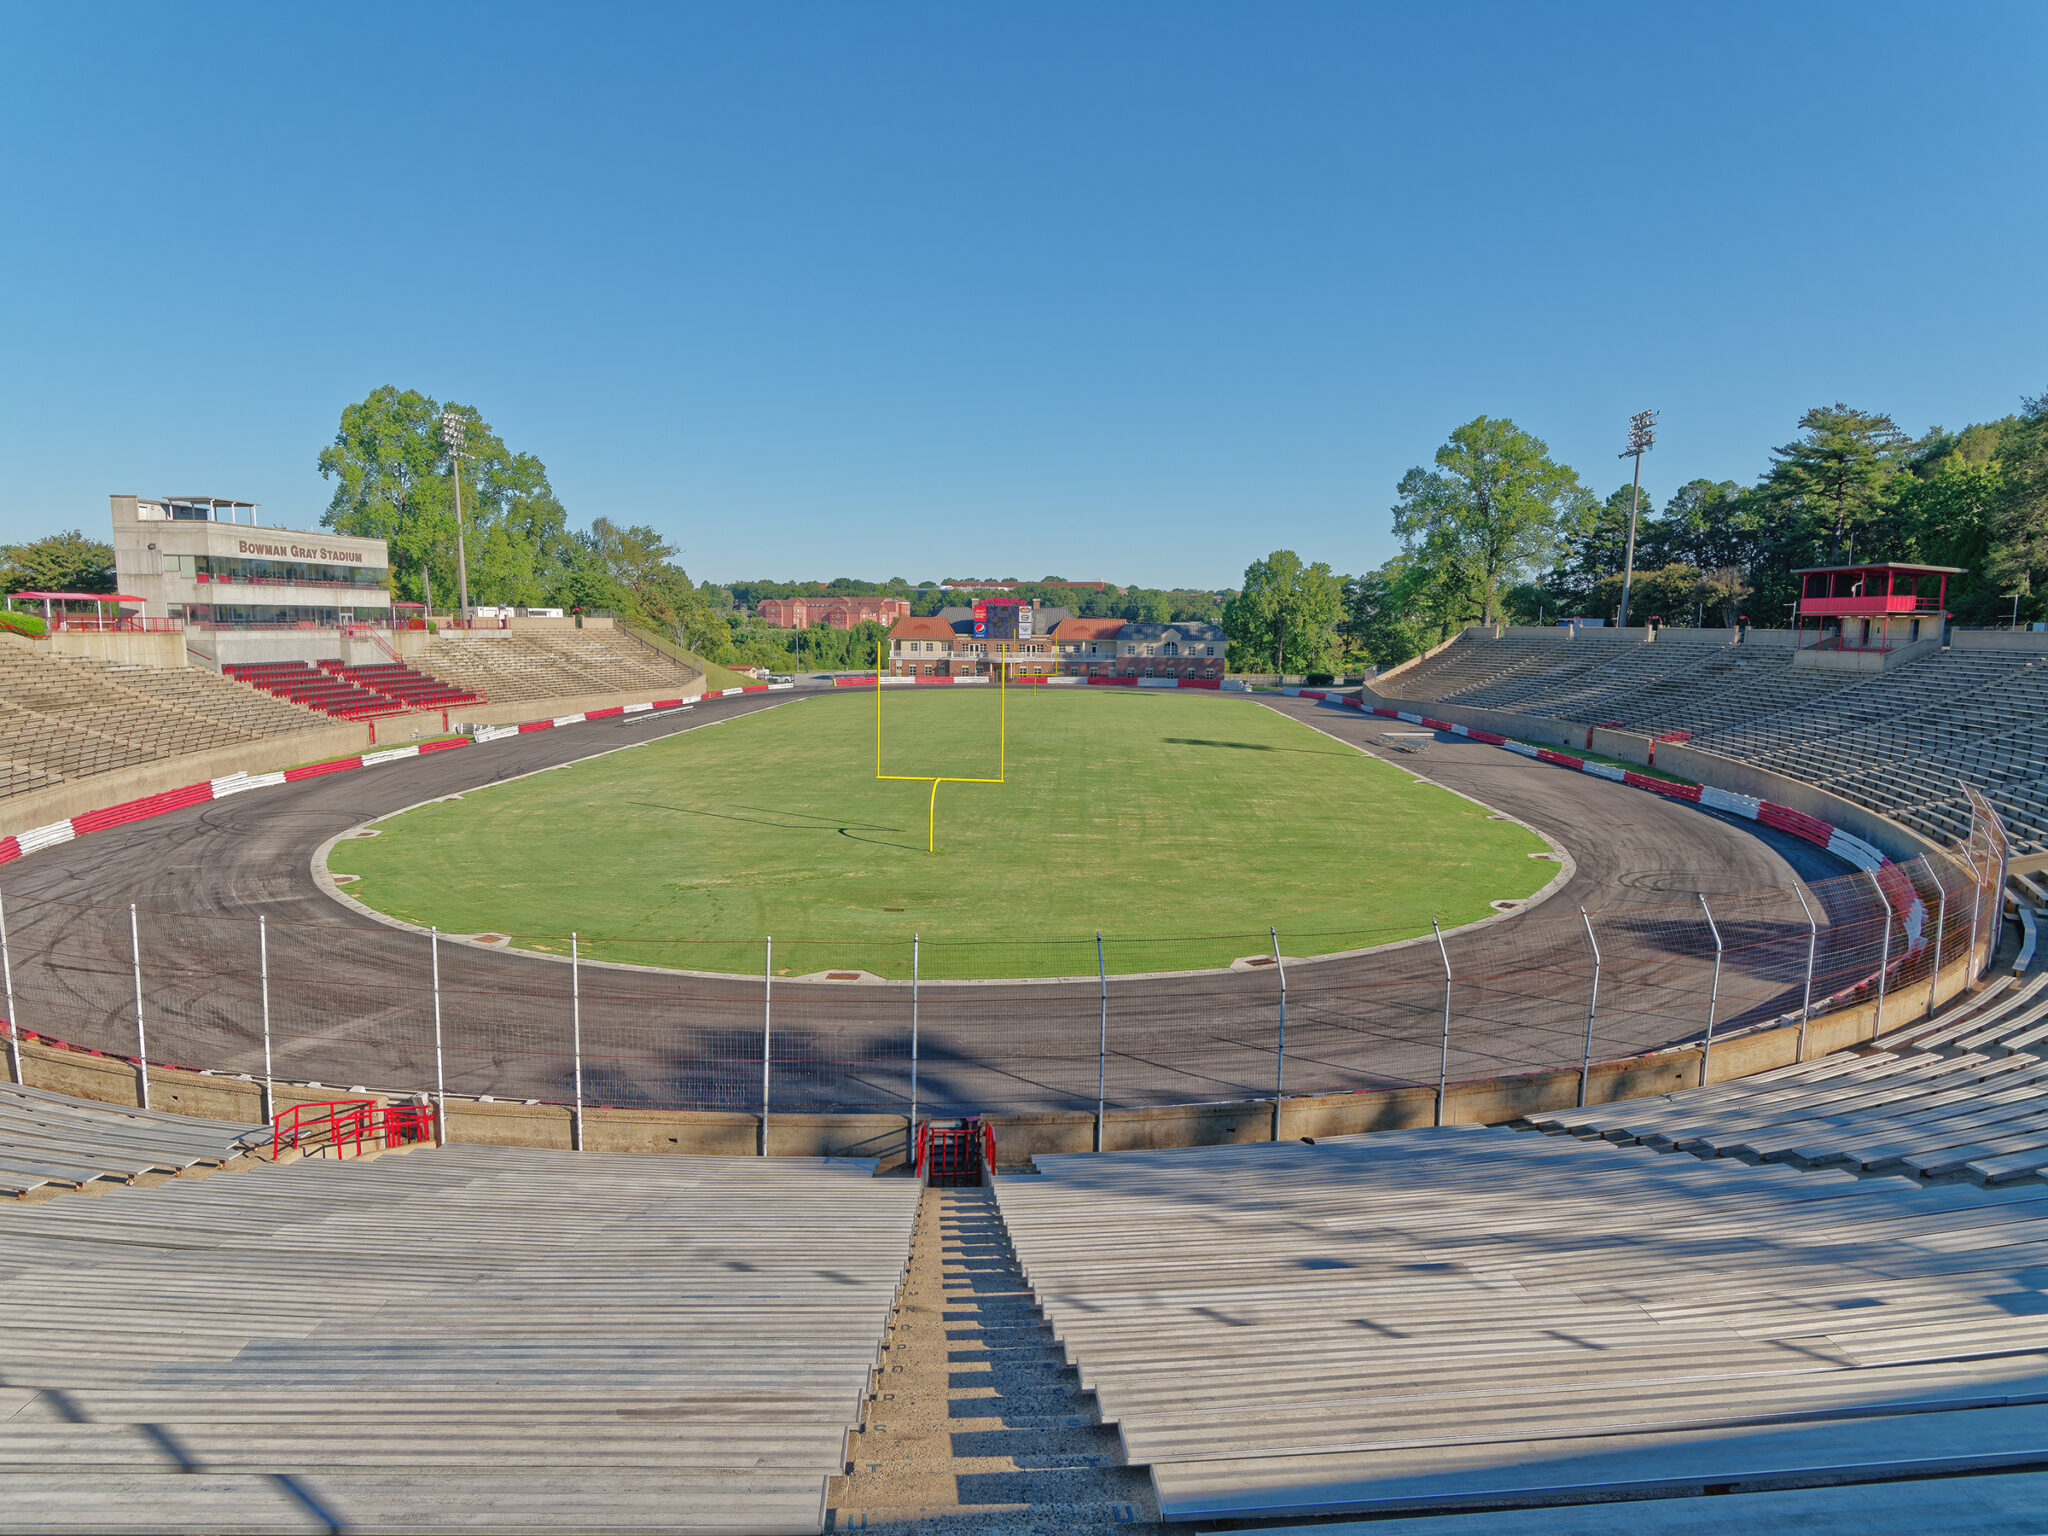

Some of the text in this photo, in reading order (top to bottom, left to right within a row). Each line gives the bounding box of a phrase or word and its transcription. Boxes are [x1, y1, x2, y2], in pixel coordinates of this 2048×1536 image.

[239, 540, 362, 563] BOWMAN GRAY STADIUM
[874, 1424, 886, 1432] S
[866, 1463, 882, 1473] T
[1086, 1458, 1100, 1467] T
[1112, 1506, 1133, 1522] U
[848, 1513, 867, 1530] U
